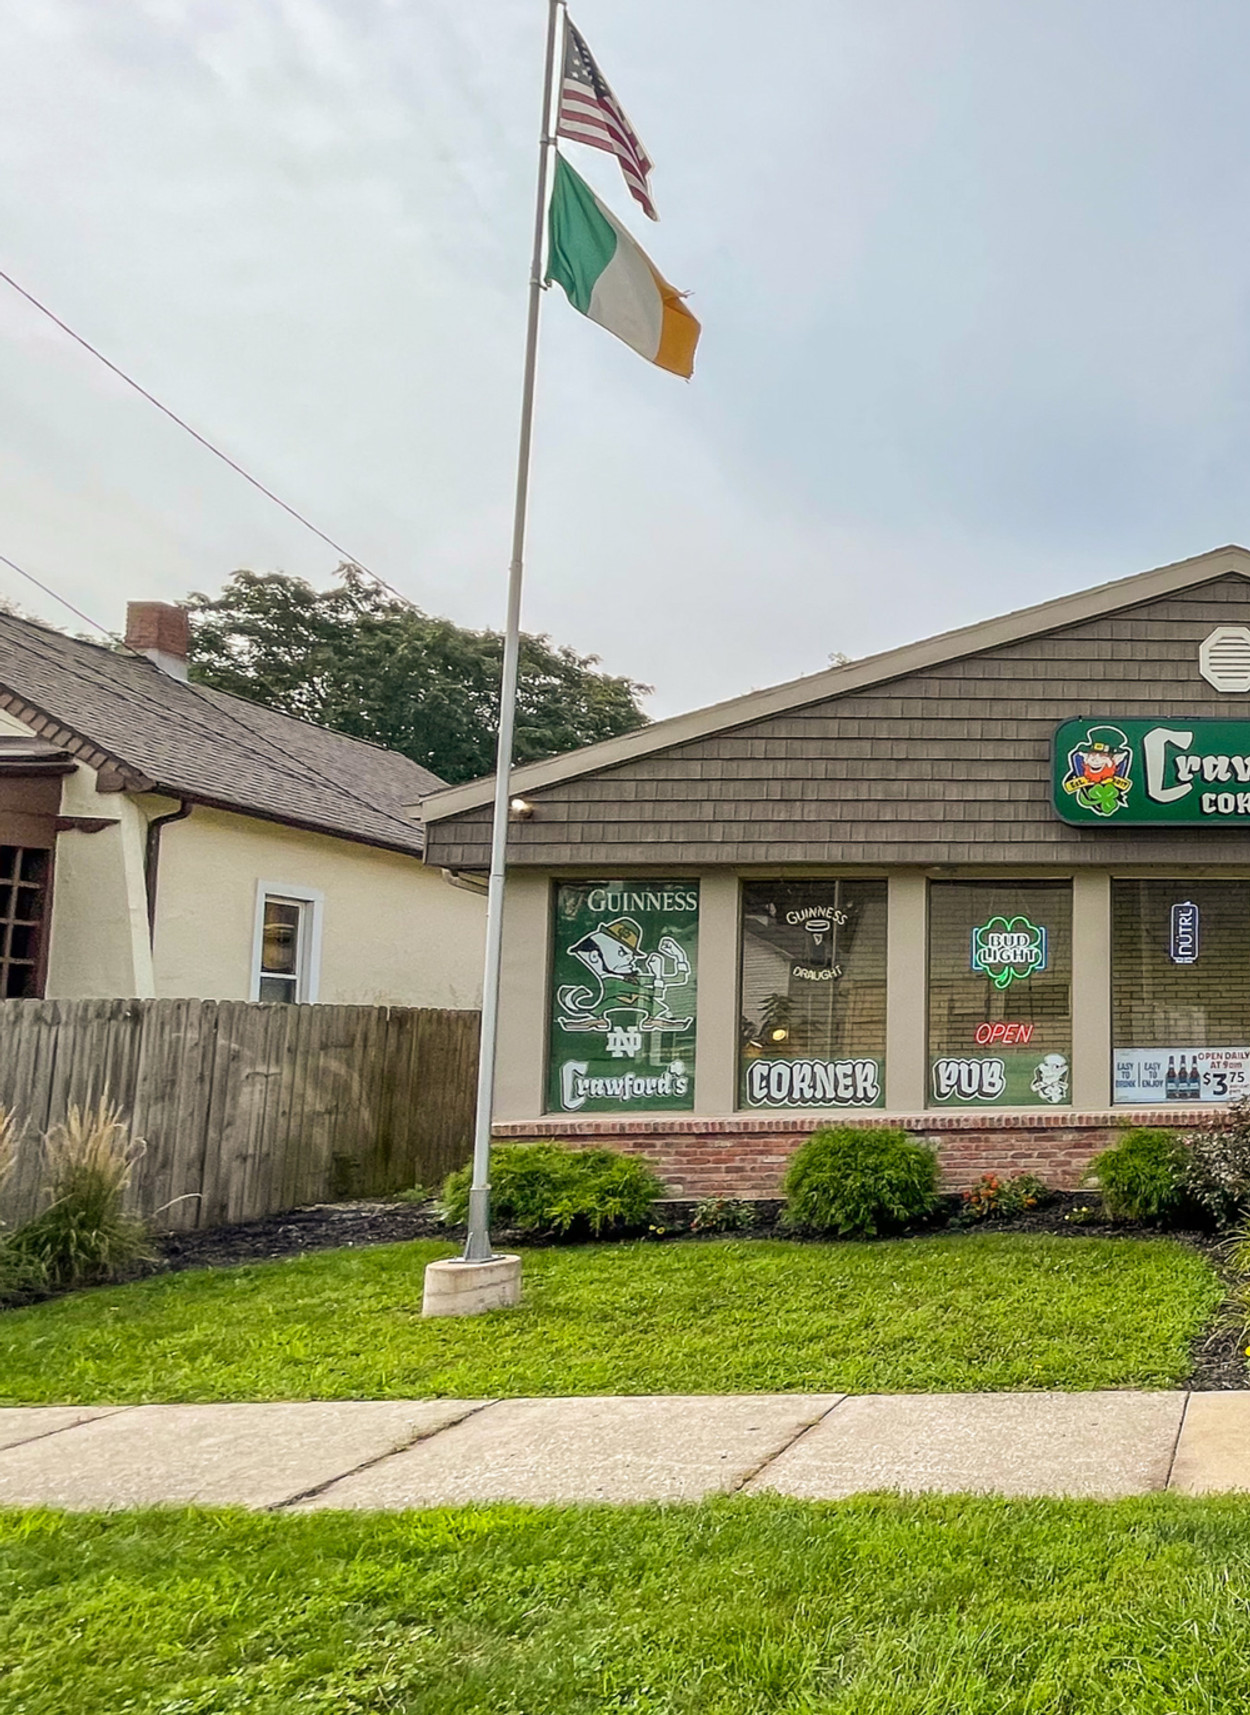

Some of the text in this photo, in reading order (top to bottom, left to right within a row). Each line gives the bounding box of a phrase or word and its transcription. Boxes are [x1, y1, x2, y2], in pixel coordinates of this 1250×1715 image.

[587, 889, 698, 913] GUINNESS
[786, 906, 848, 926] GUINNESS
[988, 932, 1031, 949] BUD
[980, 948, 1037, 964] LIGHT
[792, 965, 844, 981] DRAUGHT
[974, 1022, 1034, 1045] OPEN
[1197, 1051, 1250, 1061] OPEN DAILY
[1144, 1062, 1162, 1071] EASY
[1210, 1061, 1221, 1069] AT
[748, 1060, 880, 1105] CORNER
[933, 1058, 1006, 1101] PUB
[1121, 1071, 1131, 1079] TO
[1149, 1071, 1158, 1079] TO
[561, 1059, 689, 1112] Crawford's
[1142, 1080, 1164, 1088] ENJOY
